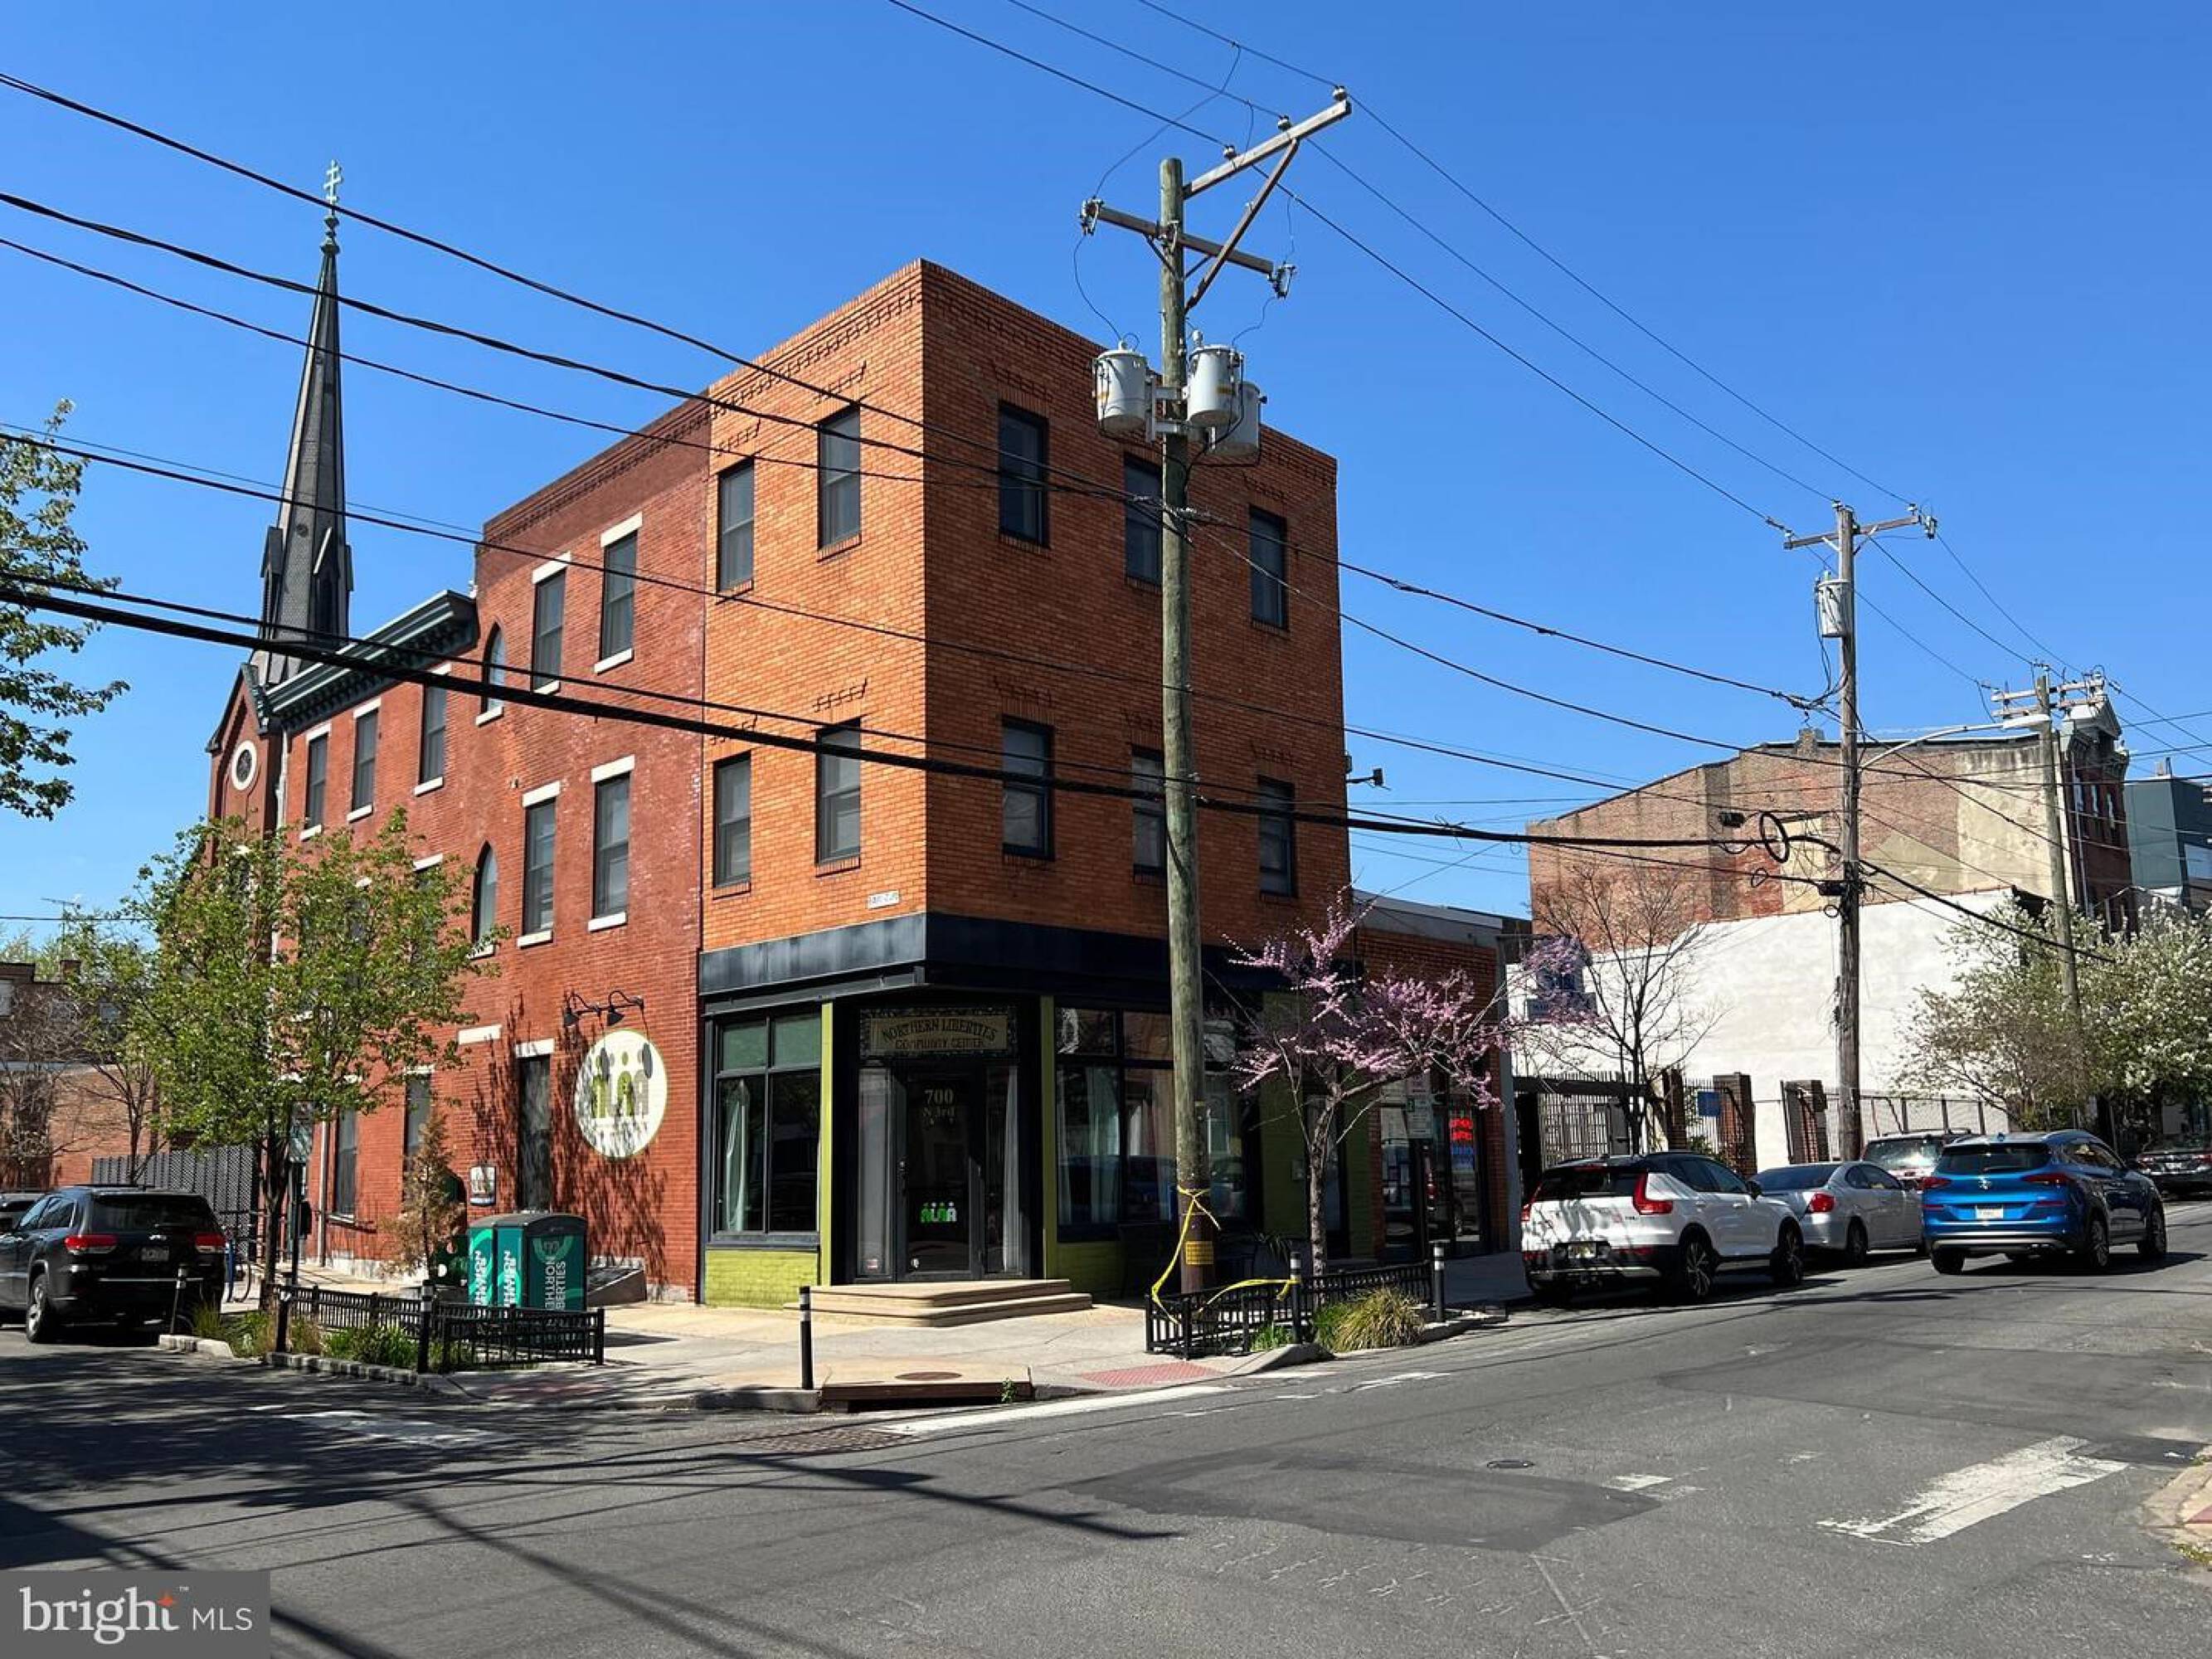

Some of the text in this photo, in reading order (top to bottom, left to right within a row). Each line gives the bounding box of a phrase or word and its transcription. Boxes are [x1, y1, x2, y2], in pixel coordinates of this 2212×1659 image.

[882, 1018, 998, 1043] NORTHERN LIBERTIES
[923, 1088, 955, 1105] 700
